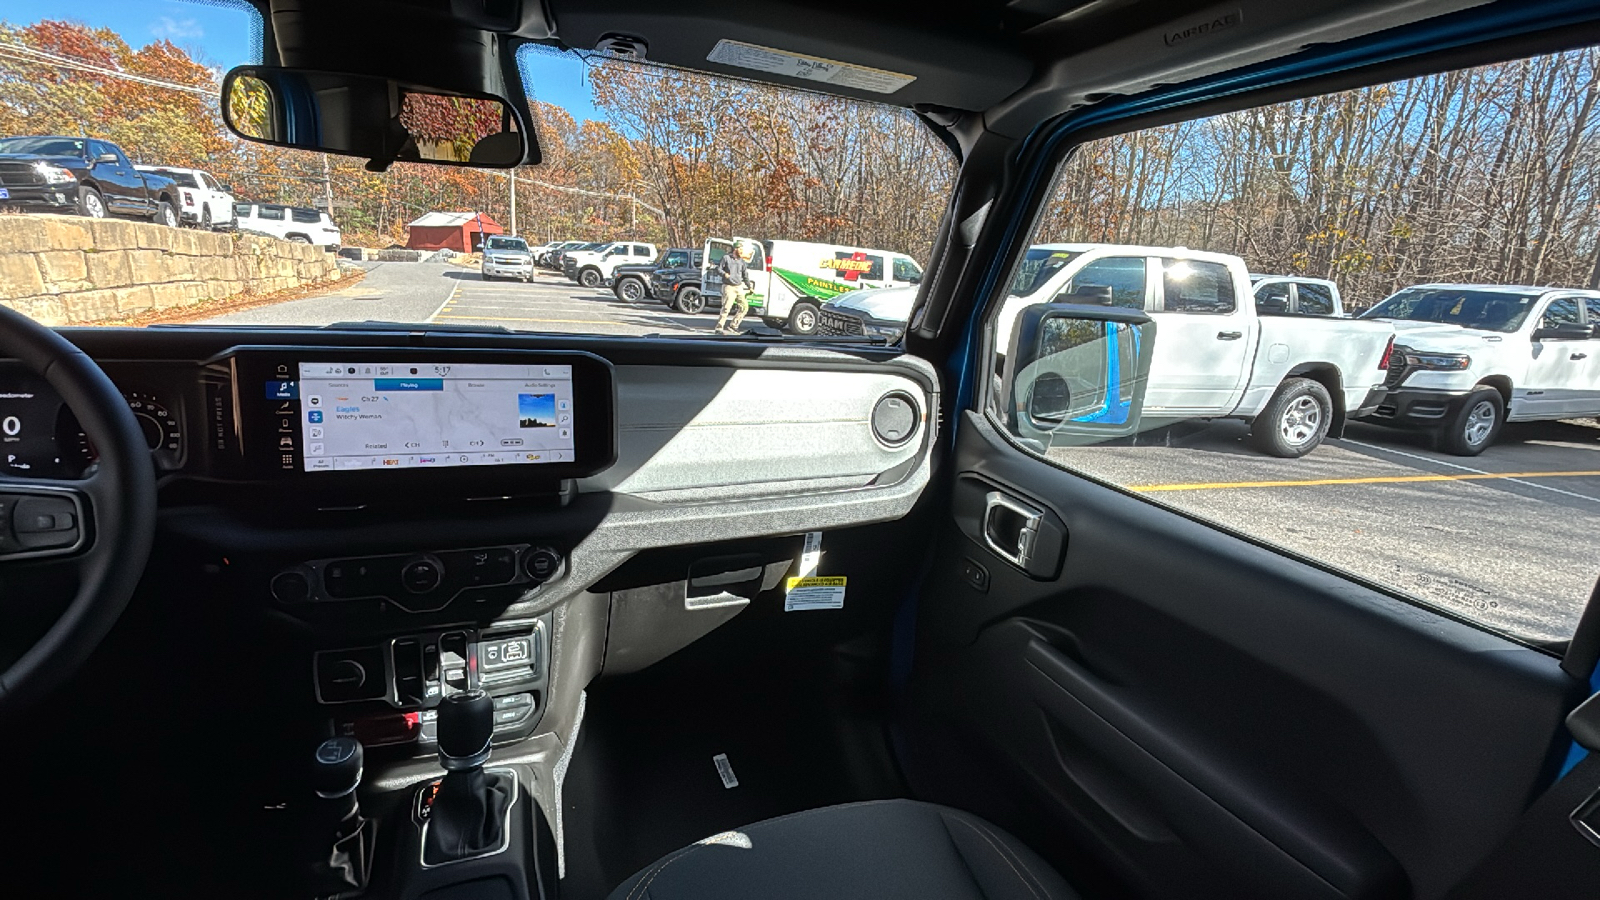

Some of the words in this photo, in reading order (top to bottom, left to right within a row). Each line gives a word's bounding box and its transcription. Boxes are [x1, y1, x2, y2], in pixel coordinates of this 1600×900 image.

[1171, 14, 1235, 42] AIRBAG
[821, 316, 843, 330] RAM
[2, 416, 21, 436] 0
[8, 454, 16, 463] P
